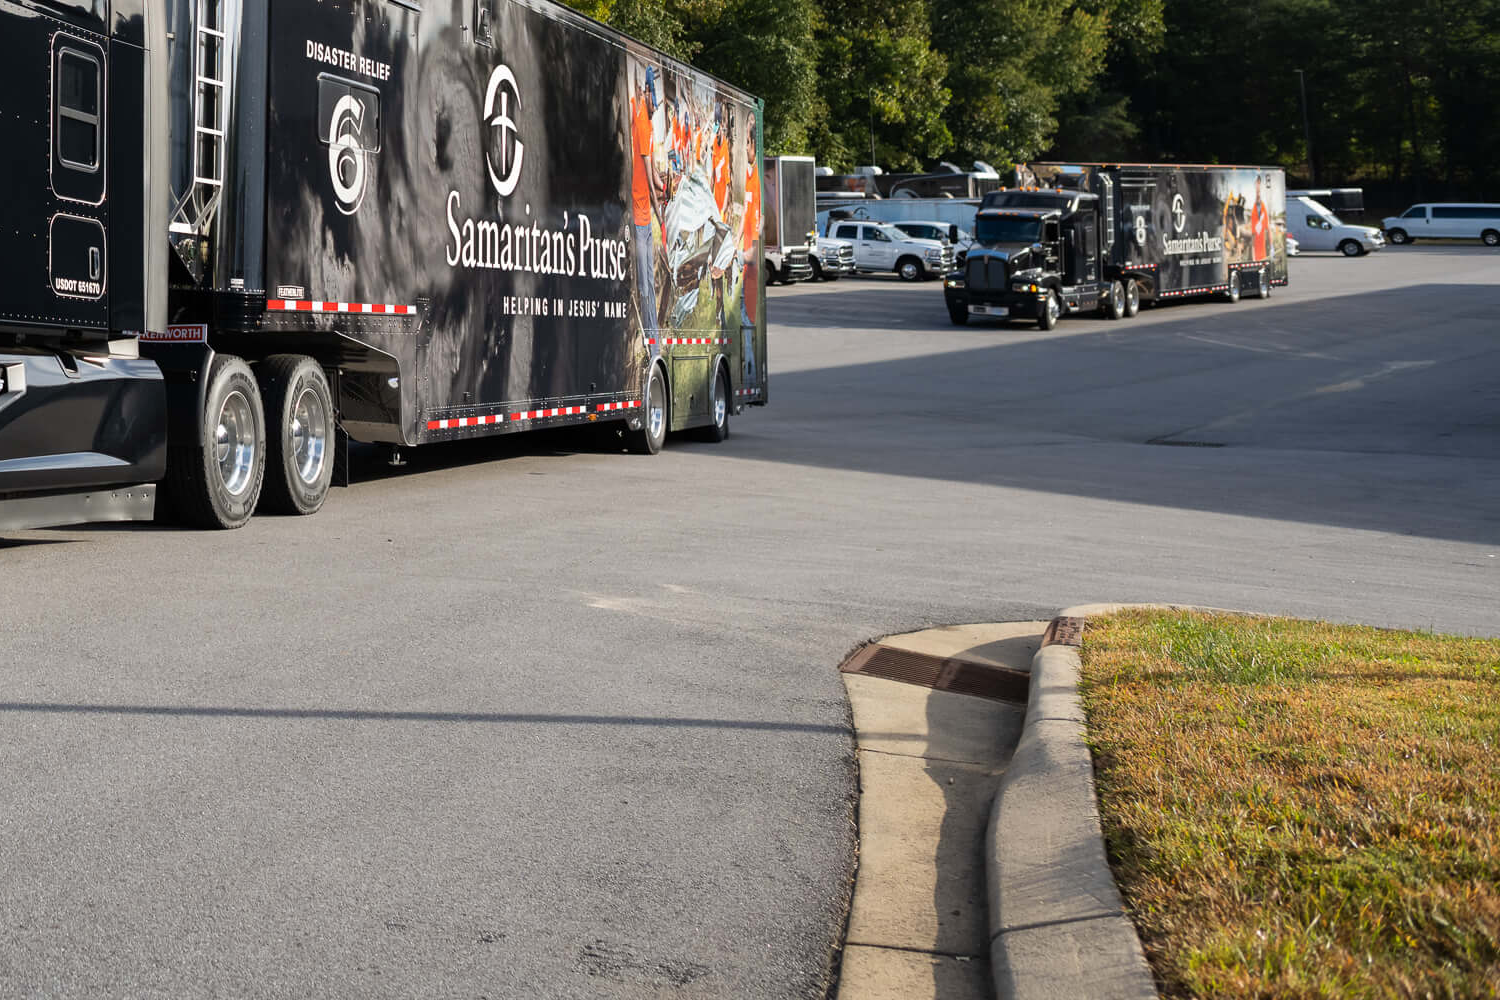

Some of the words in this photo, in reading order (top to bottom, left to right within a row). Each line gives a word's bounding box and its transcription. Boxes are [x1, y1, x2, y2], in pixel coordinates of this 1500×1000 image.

[306, 39, 357, 72] DISASTER
[359, 55, 391, 81] RELIEF
[328, 94, 367, 215] 6
[446, 190, 576, 277] Samaritan's
[1135, 215, 1147, 246] 8
[55, 277, 78, 292] USDOT
[77, 280, 101, 295] 651670
[503, 296, 549, 316] HELPING
[553, 299, 564, 317] IN
[604, 302, 627, 319] NAME
